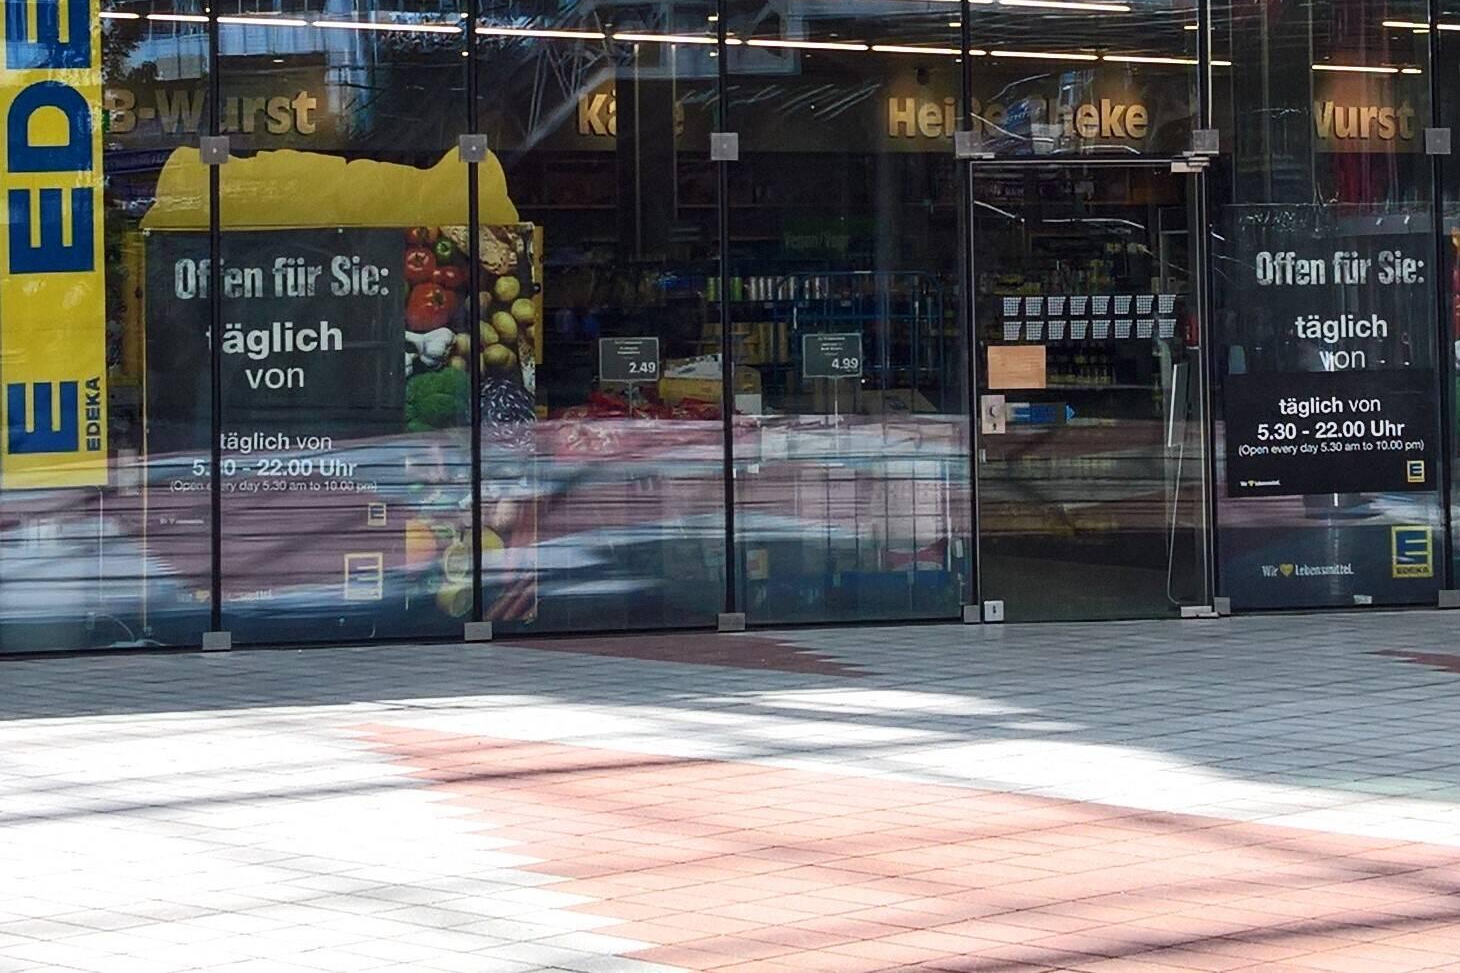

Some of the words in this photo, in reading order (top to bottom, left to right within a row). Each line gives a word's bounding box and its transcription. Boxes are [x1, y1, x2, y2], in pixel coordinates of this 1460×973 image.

[174, 258, 263, 299] Ofen
[272, 257, 322, 297] für
[331, 255, 389, 296] Sie:
[1256, 251, 1326, 285] Offen
[1333, 251, 1371, 284] für
[1378, 250, 1425, 284] Sie:
[1295, 314, 1388, 344] täglich
[628, 362, 656, 373] 2.49
[831, 358, 859, 369] 4.99
[1320, 350, 1366, 370] von
[245, 367, 304, 390] von
[85, 377, 101, 451] EDEKA
[1279, 397, 1343, 417] täglich
[1349, 399, 1381, 412] von
[7, 381, 78, 455] E
[1257, 423, 1297, 440] 5.30
[1315, 421, 1365, 438] 22.00
[1370, 420, 1405, 437] Uhr
[297, 435, 332, 450] von
[1239, 444, 1269, 457] (Open
[1271, 445, 1298, 456] every
[1300, 442, 1319, 455] day
[1320, 442, 1343, 452] 5.30
[1345, 442, 1361, 451] am
[1363, 441, 1373, 451] to
[1376, 440, 1403, 451] 10.00
[1405, 440, 1425, 452] pm)
[192, 459, 235, 477] 5.0
[257, 459, 312, 477] 22.00
[319, 458, 358, 477] Uhr
[239, 480, 260, 493] day
[263, 480, 287, 491] 5.30
